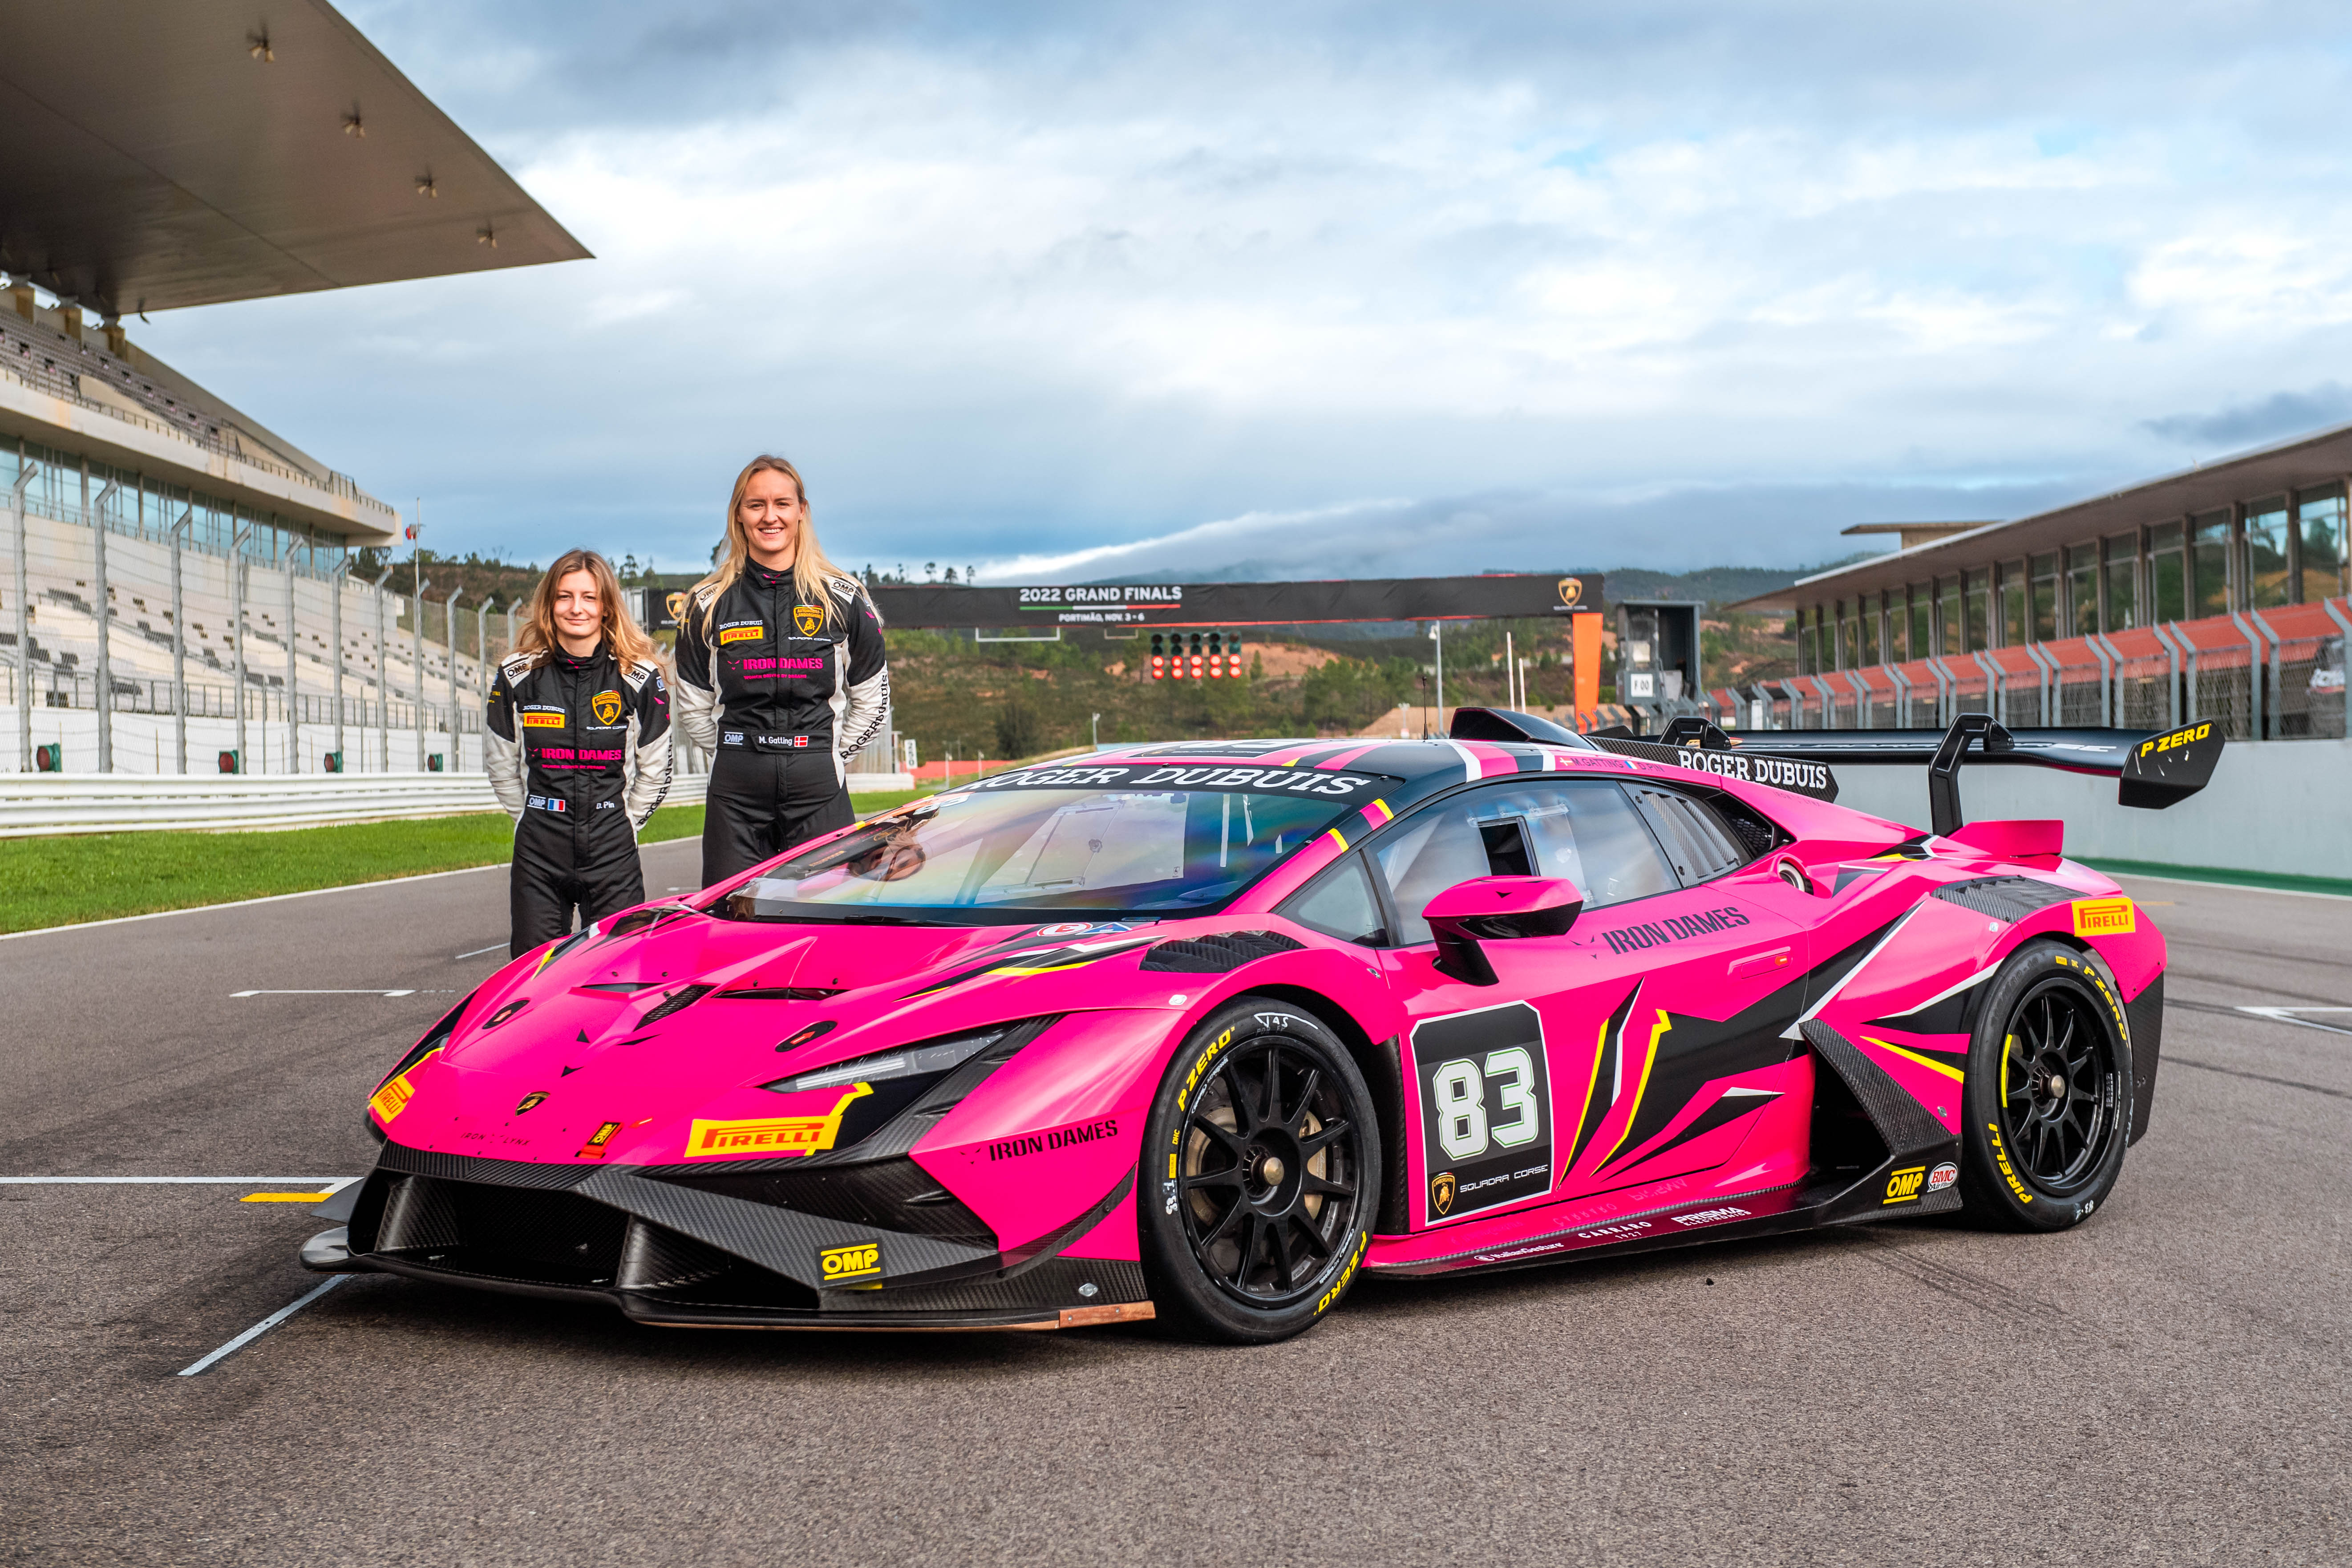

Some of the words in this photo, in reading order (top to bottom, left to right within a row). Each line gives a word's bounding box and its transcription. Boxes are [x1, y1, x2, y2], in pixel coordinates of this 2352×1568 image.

[833, 582, 854, 593] OMP
[1020, 588, 1061, 602] 2022
[1065, 587, 1121, 602] GRAND
[1124, 586, 1182, 600] FINALS
[1105, 613, 1123, 621] NOV.
[1125, 613, 1131, 621] 3
[1138, 613, 1145, 621] 6
[724, 629, 759, 641] PIRELLI
[743, 658, 776, 670] IRON
[779, 658, 823, 669] DAMES
[630, 670, 645, 681] MP
[527, 716, 561, 725] PIRELLI
[840, 721, 880, 760] ROGER
[876, 674, 888, 722] DUBUIS
[725, 734, 744, 743] OMP
[769, 736, 793, 746] Gatting
[2141, 741, 2154, 758] P
[2157, 723, 2210, 752] ZERO
[542, 748, 575, 759] IRON
[579, 749, 622, 760] DAMES
[1571, 758, 1624, 768] M.GATTING
[1637, 762, 1665, 773] D.PIN
[1678, 750, 1750, 780] ROGER
[1754, 758, 1826, 790] DUBUIS
[1129, 770, 1370, 795] DUBUIS
[529, 797, 545, 807] OMP
[2079, 904, 2129, 929] PIRELLI
[1055, 924, 1075, 932] E
[1601, 922, 1671, 955] IRON
[1662, 907, 1750, 940] DAMES
[2084, 965, 2095, 976] P
[2095, 976, 2127, 1041] ZERO
[1178, 1089, 1187, 1111] P
[1186, 1029, 1231, 1092] ZERO
[377, 1082, 409, 1114] PIRELLI
[1433, 1046, 1539, 1161] 83
[503, 1137, 531, 1147] LYNX
[594, 1124, 614, 1144] OMP
[700, 1122, 825, 1149] PIRELLI
[989, 1135, 1044, 1161] IRON
[1048, 1119, 1118, 1150] DAMES
[1172, 1129, 1180, 1145] DHC
[1988, 1123, 2033, 1204] PIRELLI
[1460, 1174, 1509, 1193] SQUADRA
[1514, 1164, 1548, 1179] CORSE
[1887, 1172, 1923, 1197] OMP
[1931, 1169, 1955, 1183] BMC
[1671, 1206, 1745, 1224] PRISMA
[1684, 1211, 1752, 1227] ELECTRONICS
[1578, 1221, 1652, 1239] CARRARO
[1615, 1232, 1642, 1240] 1927
[1360, 1231, 1367, 1252] P
[1491, 1242, 1563, 1259] ItalianGesture
[822, 1249, 879, 1274] OMP
[1318, 1250, 1359, 1313] ZERO
